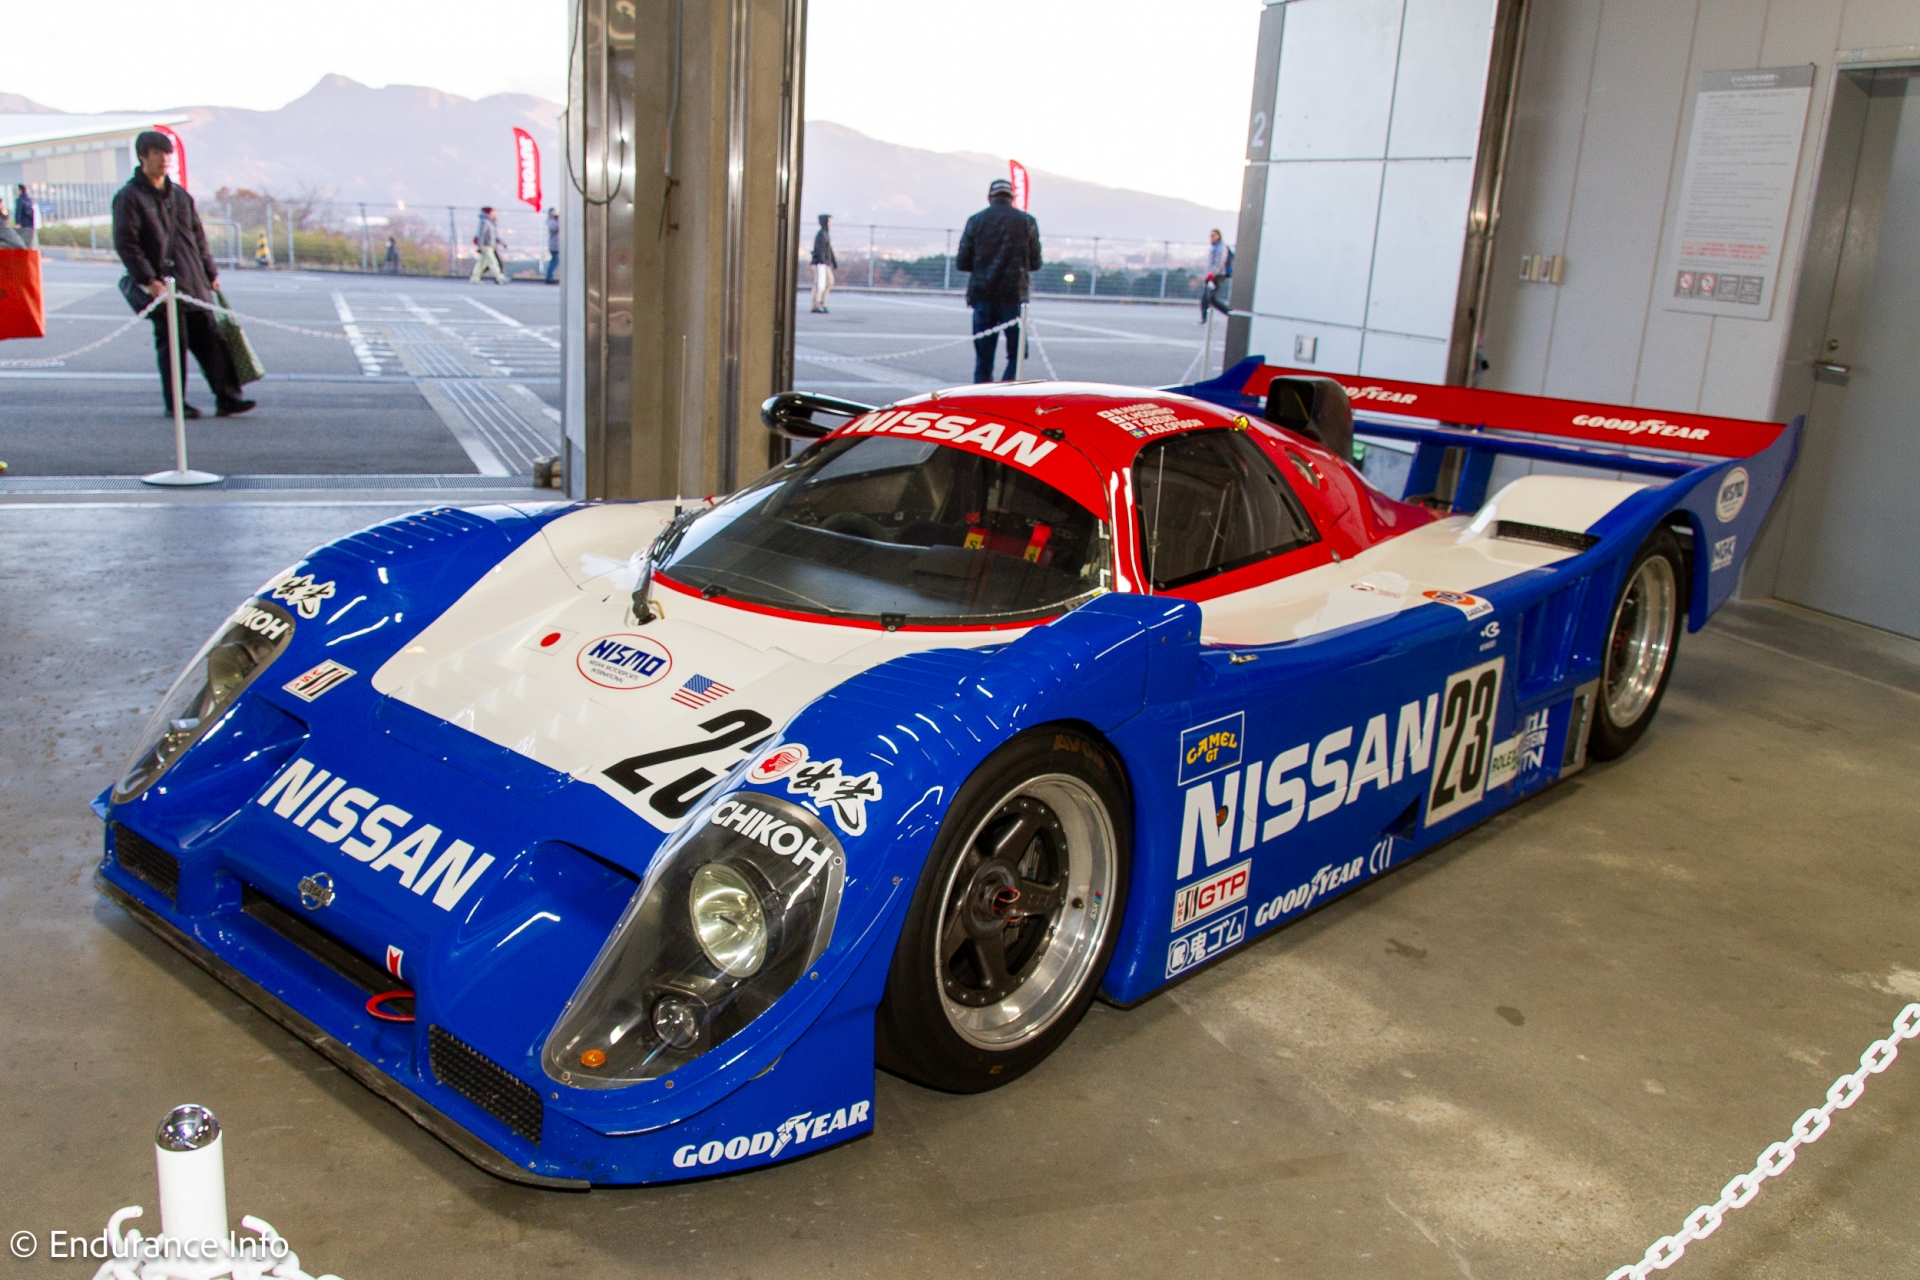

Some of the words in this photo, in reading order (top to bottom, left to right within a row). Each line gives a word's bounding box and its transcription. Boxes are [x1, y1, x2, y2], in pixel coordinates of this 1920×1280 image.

[1251, 110, 1268, 148] 2
[842, 410, 1058, 468] NISSAN
[233, 605, 291, 641] IKOH
[588, 638, 667, 678] NISMO
[1185, 731, 1239, 766] CAMEL
[1205, 748, 1220, 764] GT
[1429, 668, 1497, 812] 23
[1177, 692, 1440, 880] NISSAN
[257, 757, 496, 912] NISSAN
[1198, 869, 1247, 911] GTP
